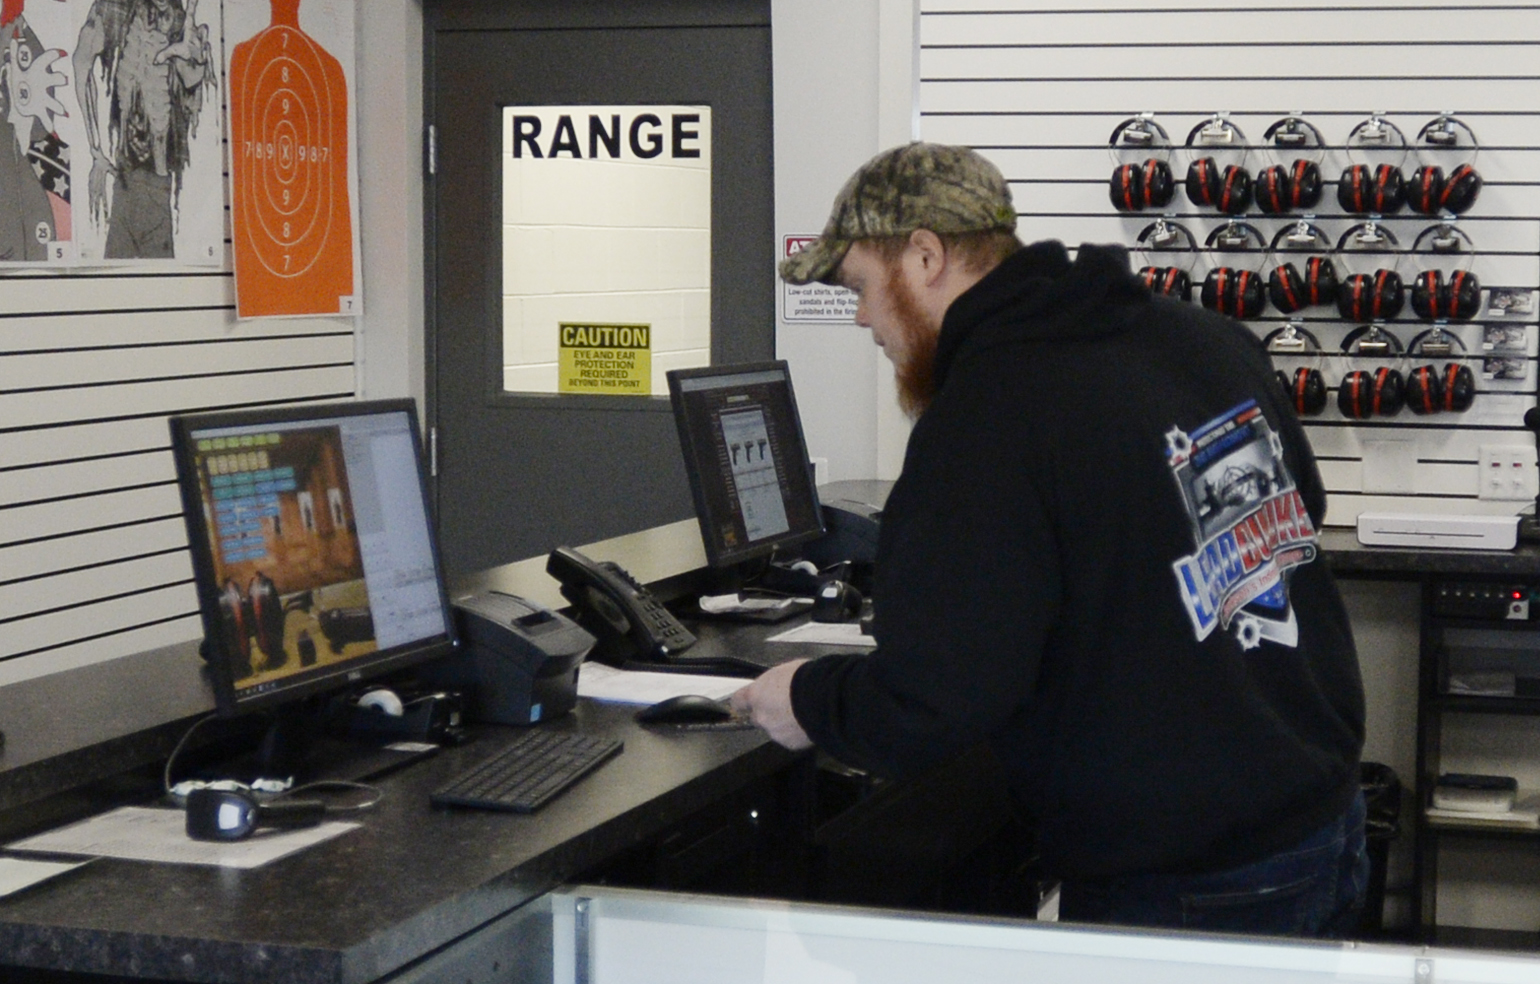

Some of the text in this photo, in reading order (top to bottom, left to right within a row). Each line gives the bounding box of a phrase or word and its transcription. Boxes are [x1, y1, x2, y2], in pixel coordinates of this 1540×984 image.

[281, 33, 288, 49] 7
[281, 67, 289, 83] 8
[281, 99, 290, 115] 9
[512, 113, 701, 159] RANGE
[281, 190, 290, 205] 9
[38, 227, 48, 239] 25
[282, 222, 290, 237] 8
[56, 249, 63, 258] 5
[283, 255, 290, 270] 7
[562, 327, 648, 347] CAUTION
[573, 350, 636, 360] EYE AND EAR
[574, 360, 635, 369] PROTECTION
[580, 369, 629, 379] REQUIRED
[568, 379, 640, 388] BEYOND THIS POINT
